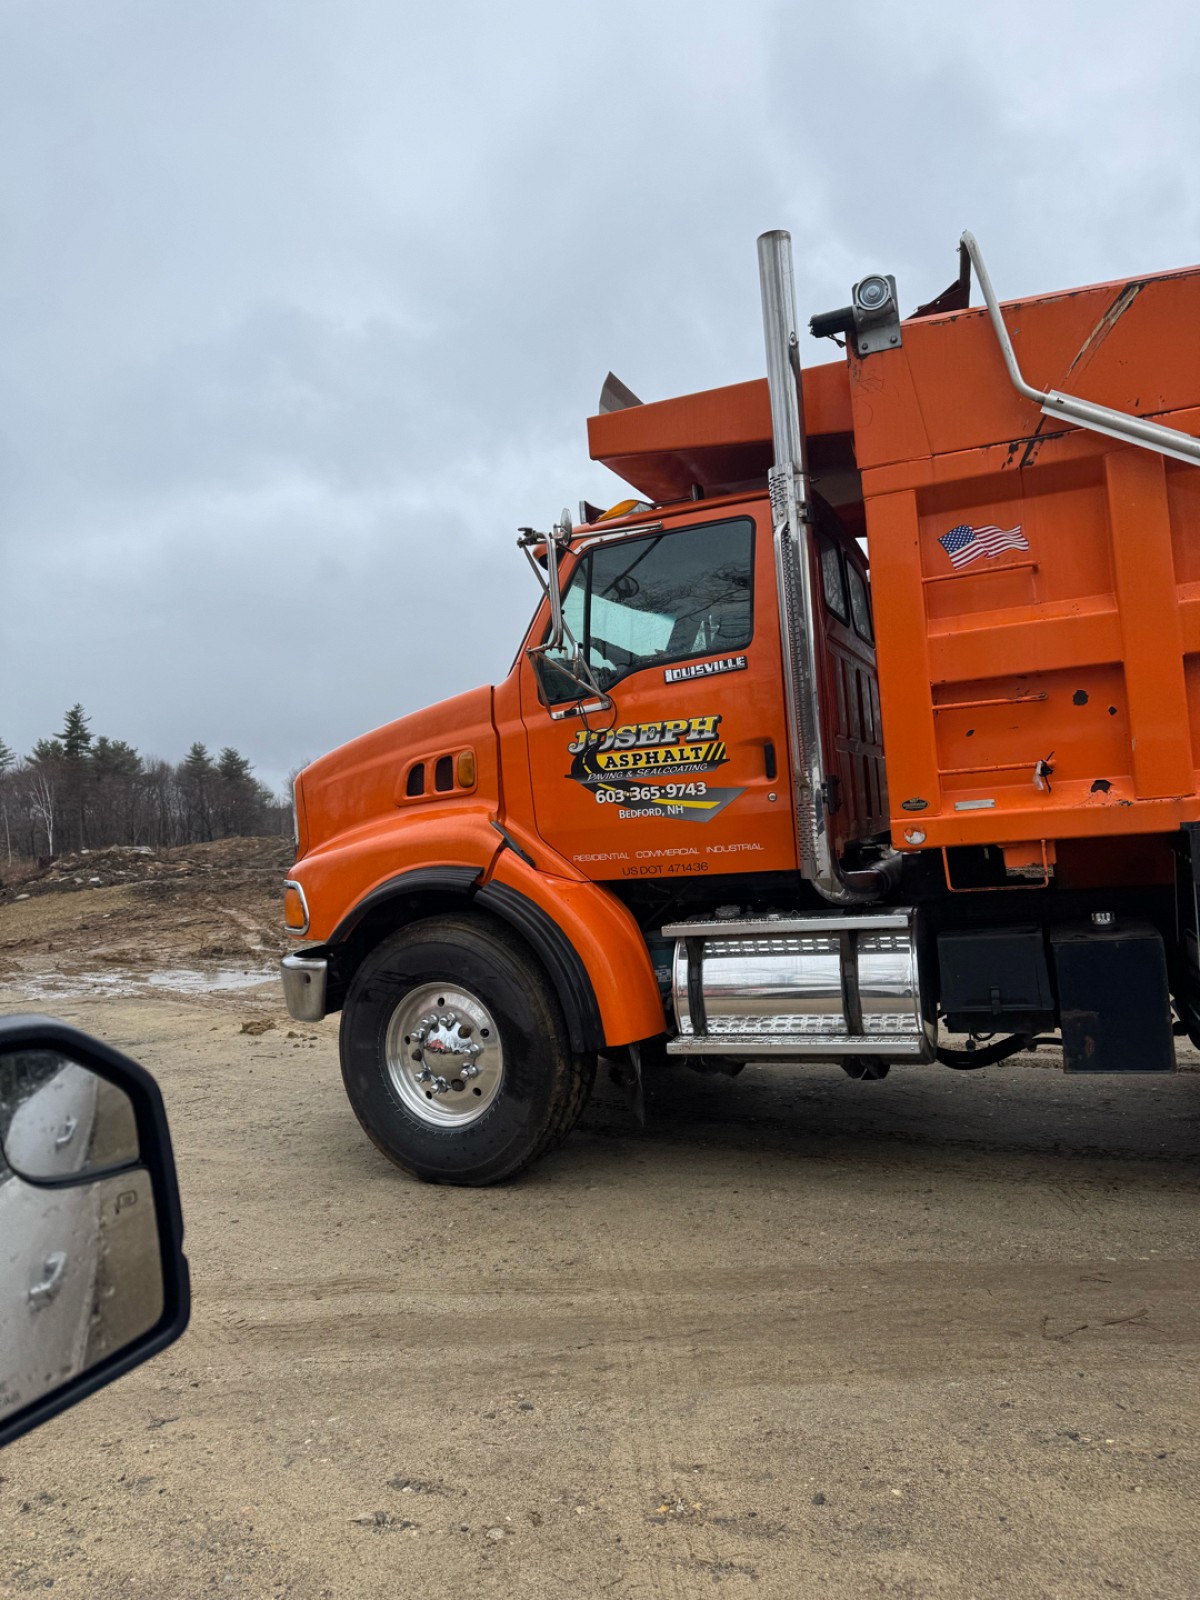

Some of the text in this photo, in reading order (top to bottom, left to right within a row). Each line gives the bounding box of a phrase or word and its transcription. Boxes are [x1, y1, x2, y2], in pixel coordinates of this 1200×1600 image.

[665, 656, 747, 683] LOUISVILLE
[568, 715, 721, 754] JOSEPH
[604, 746, 703, 769] ASPHALT
[587, 762, 708, 782] PAVING & SEALCOATING
[619, 804, 684, 820] BEDFORD, NH
[573, 842, 765, 862] RESIDENTIAL COMMERCIAL INDUSTRIAL
[667, 862, 709, 874] 471436
